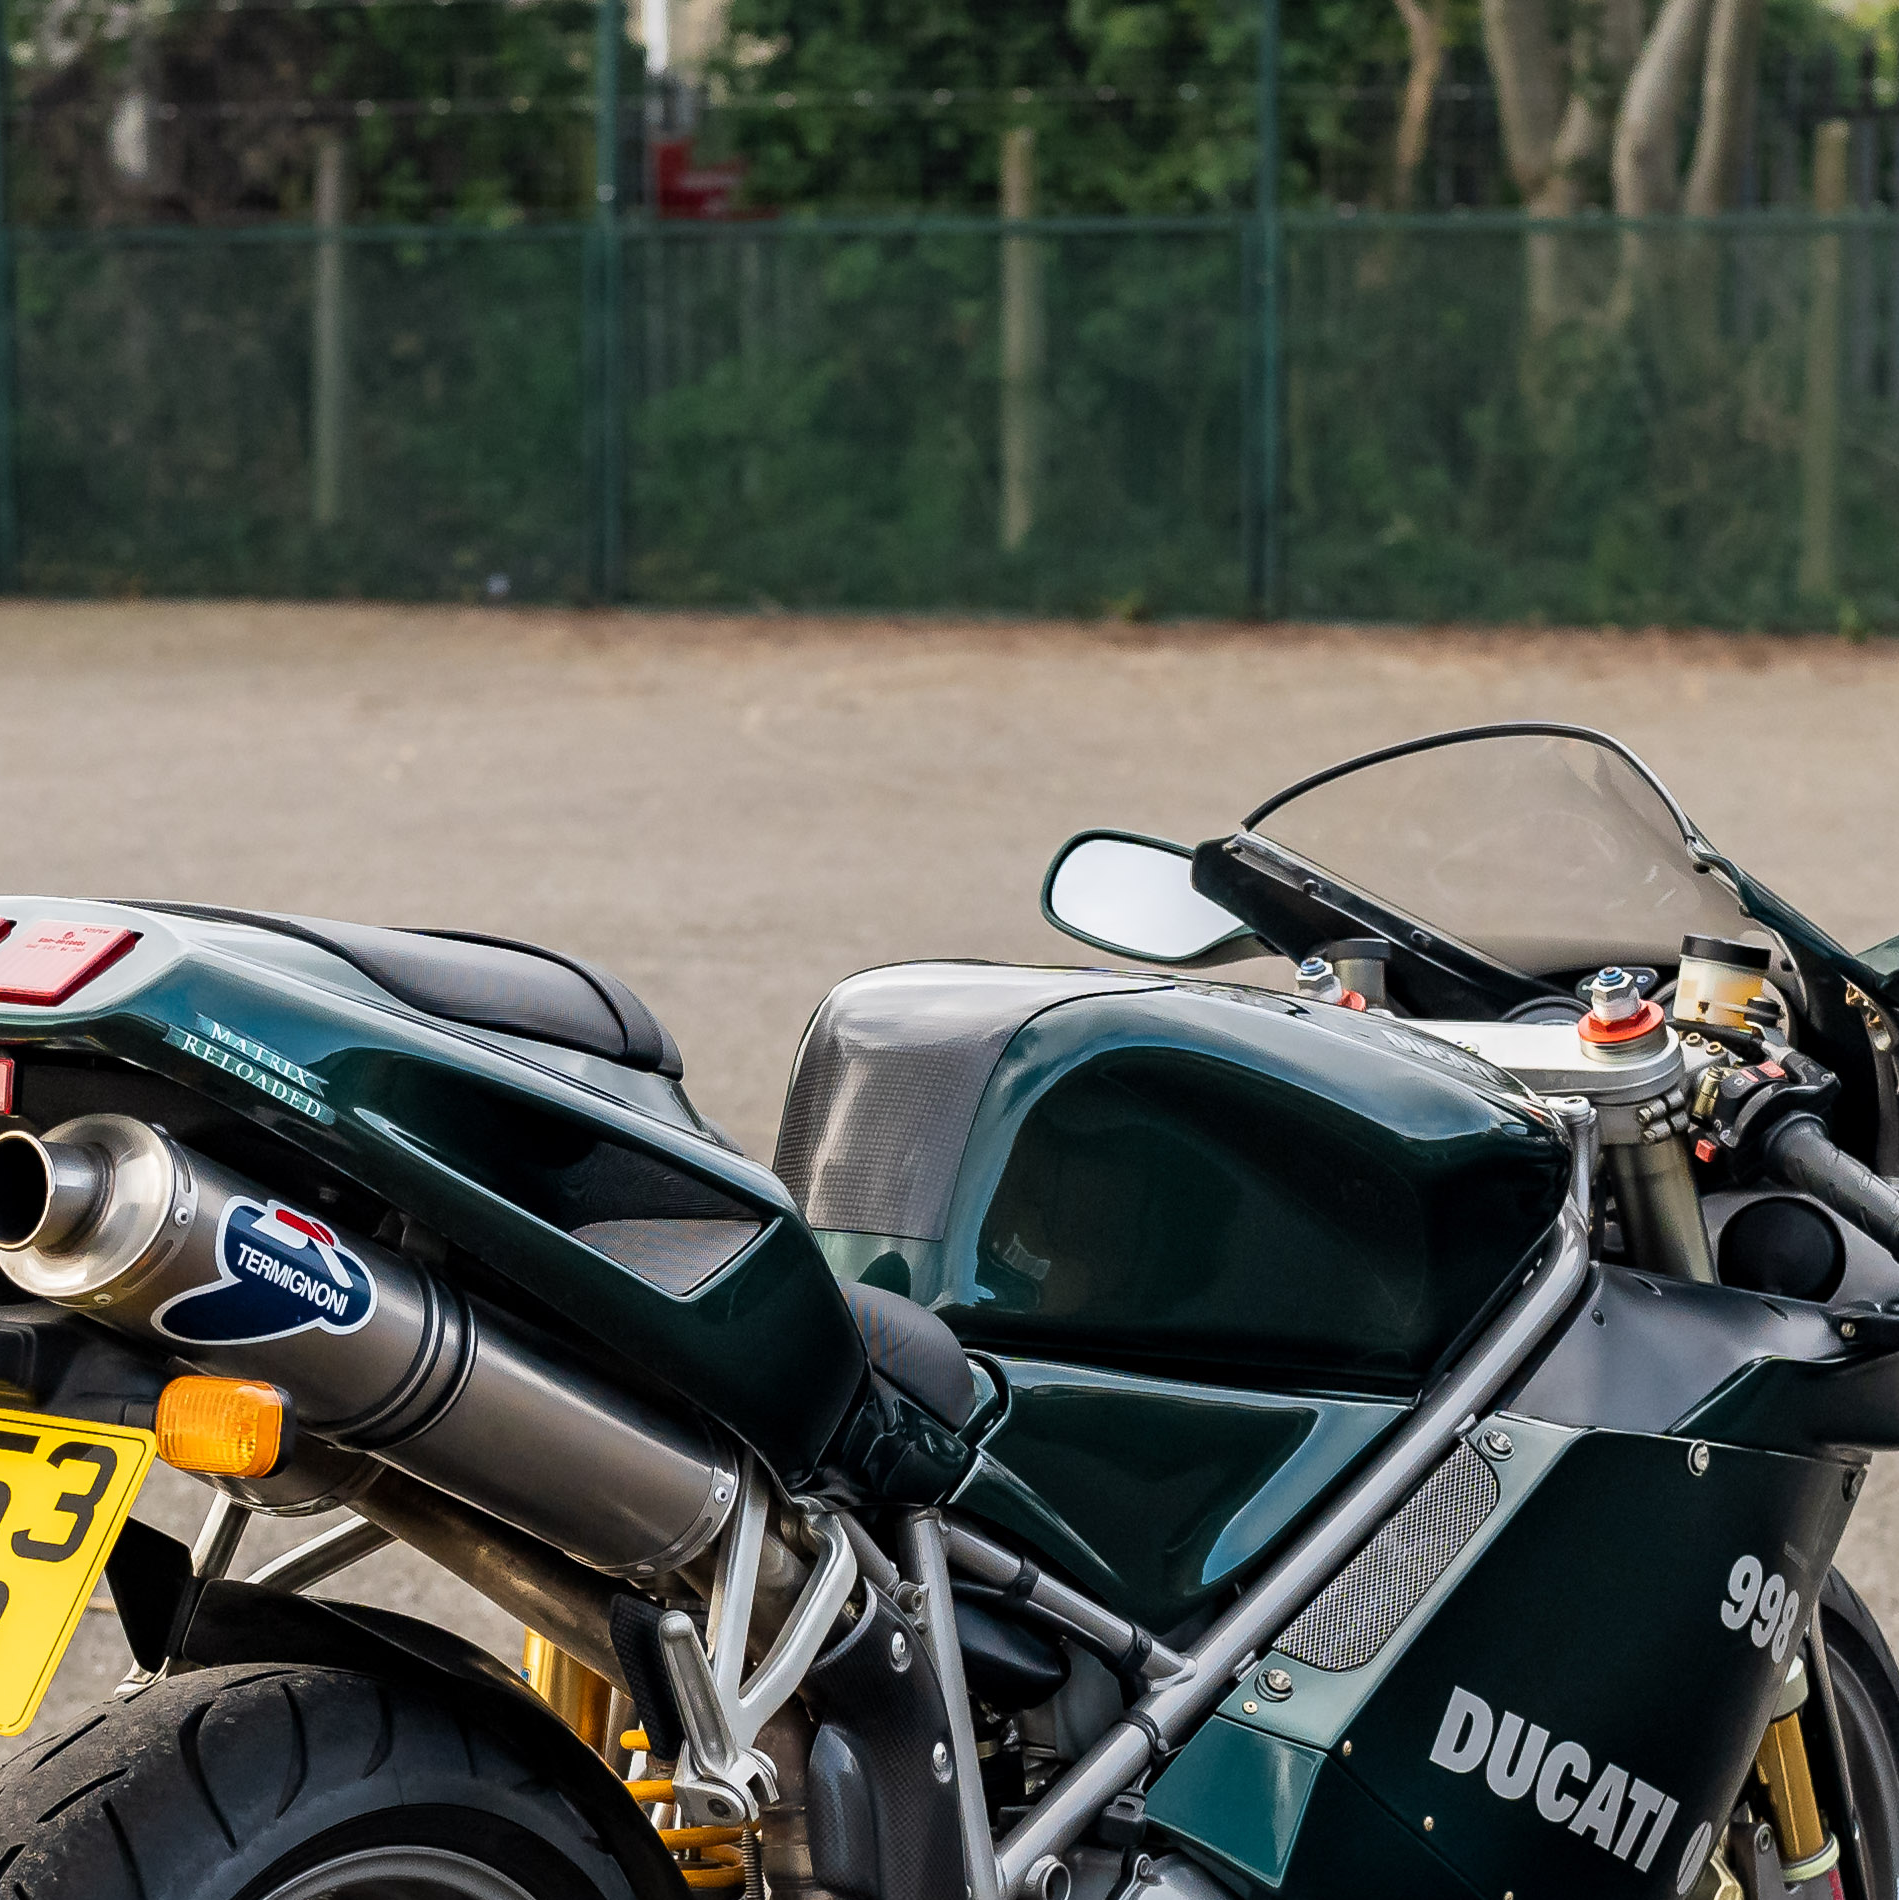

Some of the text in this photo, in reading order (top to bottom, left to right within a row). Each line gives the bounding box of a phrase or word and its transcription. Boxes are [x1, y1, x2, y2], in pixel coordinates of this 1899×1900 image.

[181, 1033, 322, 1118] RELOADED
[211, 1022, 313, 1088] MATRIX
[237, 1242, 349, 1316] TERMIGNONI
[1720, 1554, 1800, 1663] 998
[1428, 1685, 1680, 1873] DUCATI
